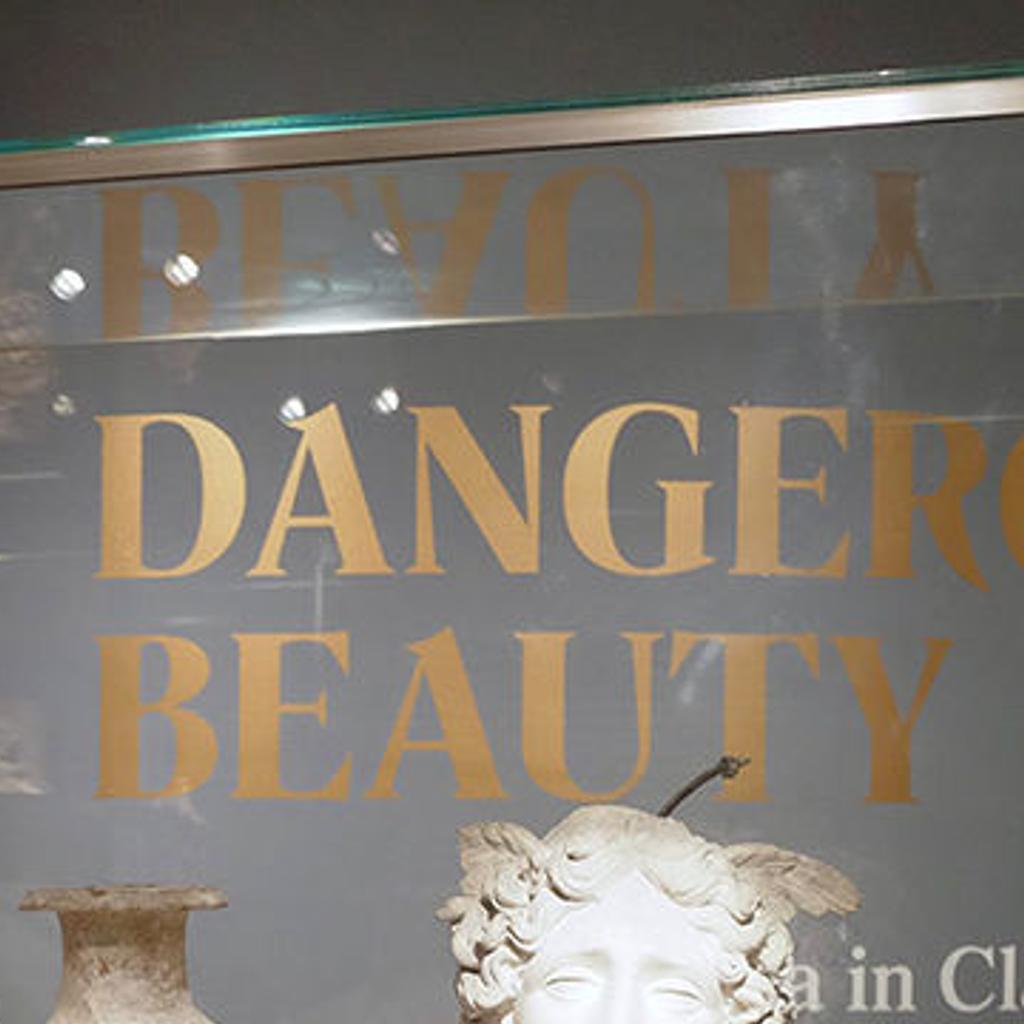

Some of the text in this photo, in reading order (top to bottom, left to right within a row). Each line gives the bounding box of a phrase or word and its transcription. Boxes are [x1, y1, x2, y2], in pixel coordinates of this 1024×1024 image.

[93, 402, 1024, 592] DANGER
[93, 626, 953, 803] BEAUTY
[847, 946, 917, 1013] in
[939, 944, 1024, 1014] Cl
